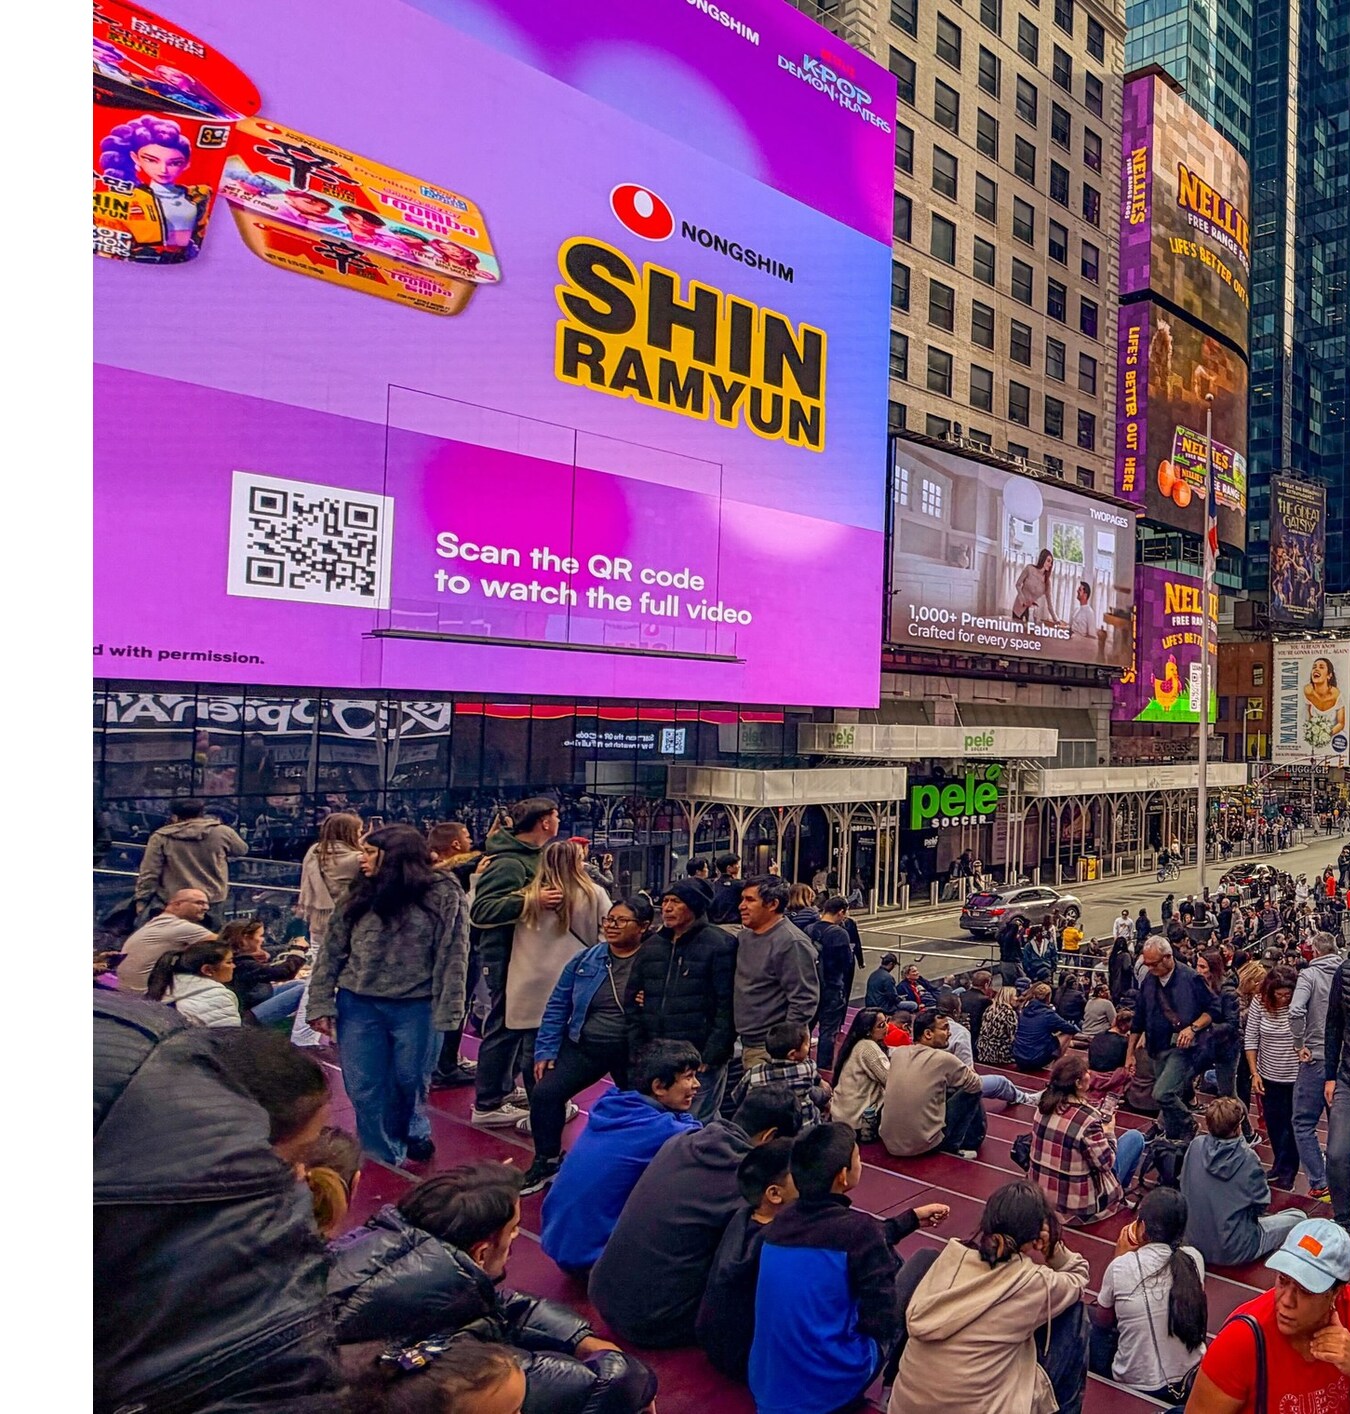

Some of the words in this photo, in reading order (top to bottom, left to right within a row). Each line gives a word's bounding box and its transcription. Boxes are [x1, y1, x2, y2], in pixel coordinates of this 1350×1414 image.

[777, 54, 835, 101] DEMON
[839, 95, 892, 134] HUNTERS
[681, 220, 795, 284] NONGSHIM
[1188, 212, 1209, 235] FREE
[1212, 227, 1238, 256] RANGE
[1169, 237, 1198, 259] LIFE'S
[1199, 246, 1232, 287] BETTER
[560, 242, 824, 402] SHIN
[1126, 326, 1141, 366] LIFE'S
[560, 325, 822, 449] RAMYUN
[1125, 422, 1138, 451] OUT
[1121, 457, 1136, 493] HERE
[1089, 507, 1129, 529] TWOPAGES
[1278, 497, 1293, 515] THE
[1294, 504, 1320, 523] GREAT
[1283, 514, 1317, 533] GATSBY
[435, 531, 521, 568] Scan
[529, 547, 580, 575] the
[587, 554, 634, 583] QR
[640, 567, 706, 593] code
[434, 568, 471, 595] to
[480, 577, 578, 607] watch
[586, 586, 633, 613] the
[639, 592, 680, 619] full
[686, 599, 753, 626] video
[907, 623, 956, 641] Crafted
[958, 626, 975, 642] for
[977, 632, 1009, 649] every
[1010, 637, 1042, 651] space
[908, 603, 957, 624] 1,000+
[961, 611, 1024, 634] Premium
[1027, 621, 1071, 640] Fabrics
[1172, 615, 1190, 627] FREE
[109, 645, 153, 660] with
[157, 648, 266, 667] permission.
[1162, 632, 1183, 650] LIFE'S
[1280, 693, 1298, 745] MAMMA
[964, 729, 995, 751] pelé
[911, 763, 1002, 831] pelé
[931, 815, 987, 829] SOCCER
